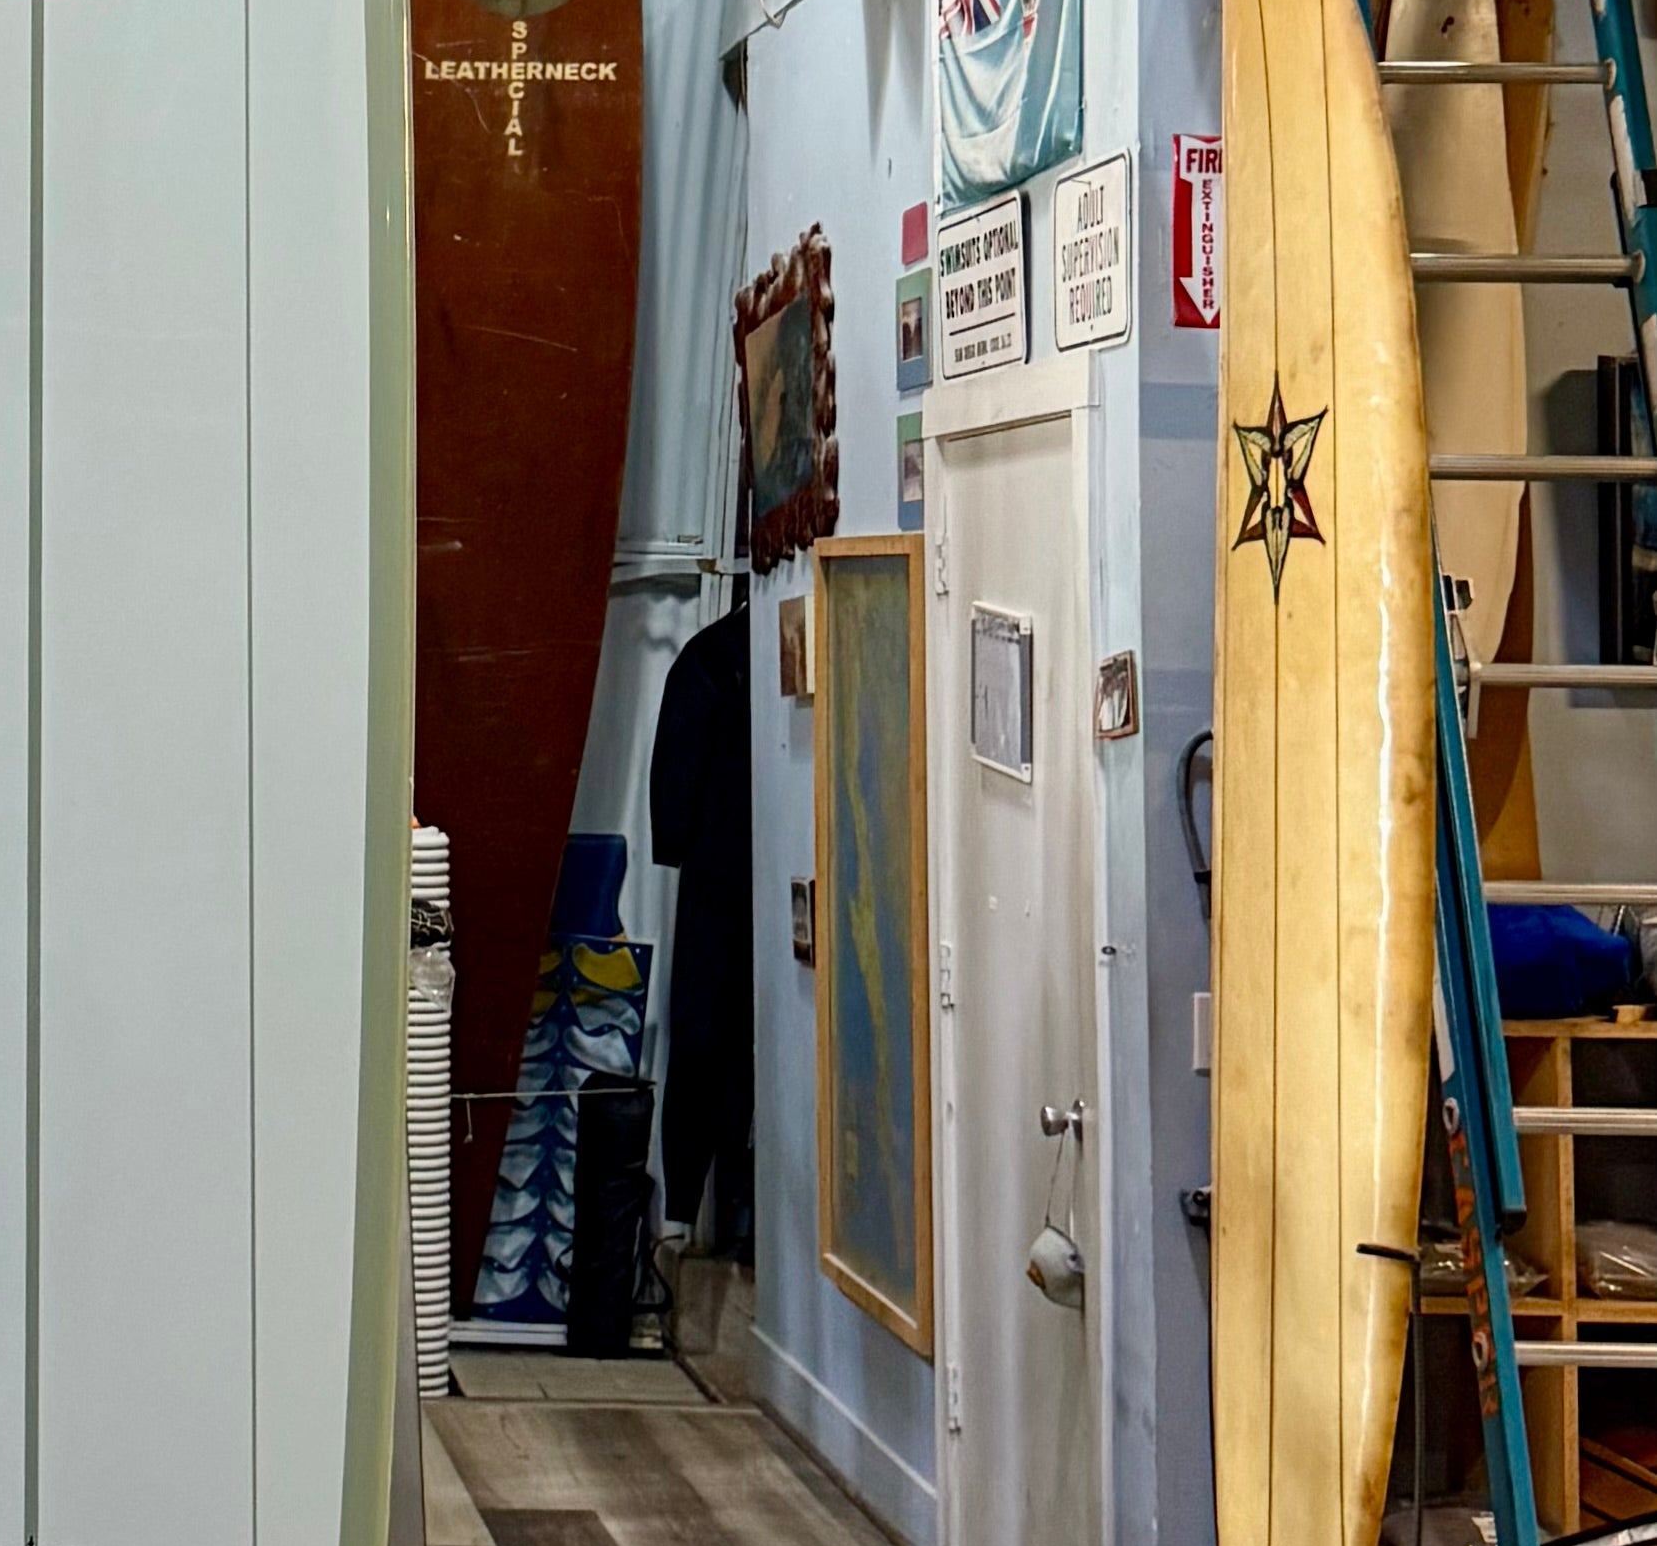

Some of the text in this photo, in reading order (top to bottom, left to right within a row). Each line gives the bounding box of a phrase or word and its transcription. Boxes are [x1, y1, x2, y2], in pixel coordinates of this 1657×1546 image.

[424, 60, 618, 82] LEATHERNECK
[504, 20, 528, 156] SPECIAL
[1186, 148, 1223, 174] FIR
[1076, 185, 1104, 233] ADULT
[940, 220, 1019, 278] SWIMSUITS OPTIONAL
[1062, 227, 1120, 283] SUPERVISION
[1202, 179, 1214, 310] EXTINGUISHER
[945, 267, 1016, 320] BEYOND THIS POINT
[1069, 276, 1113, 326] REQUIRED
